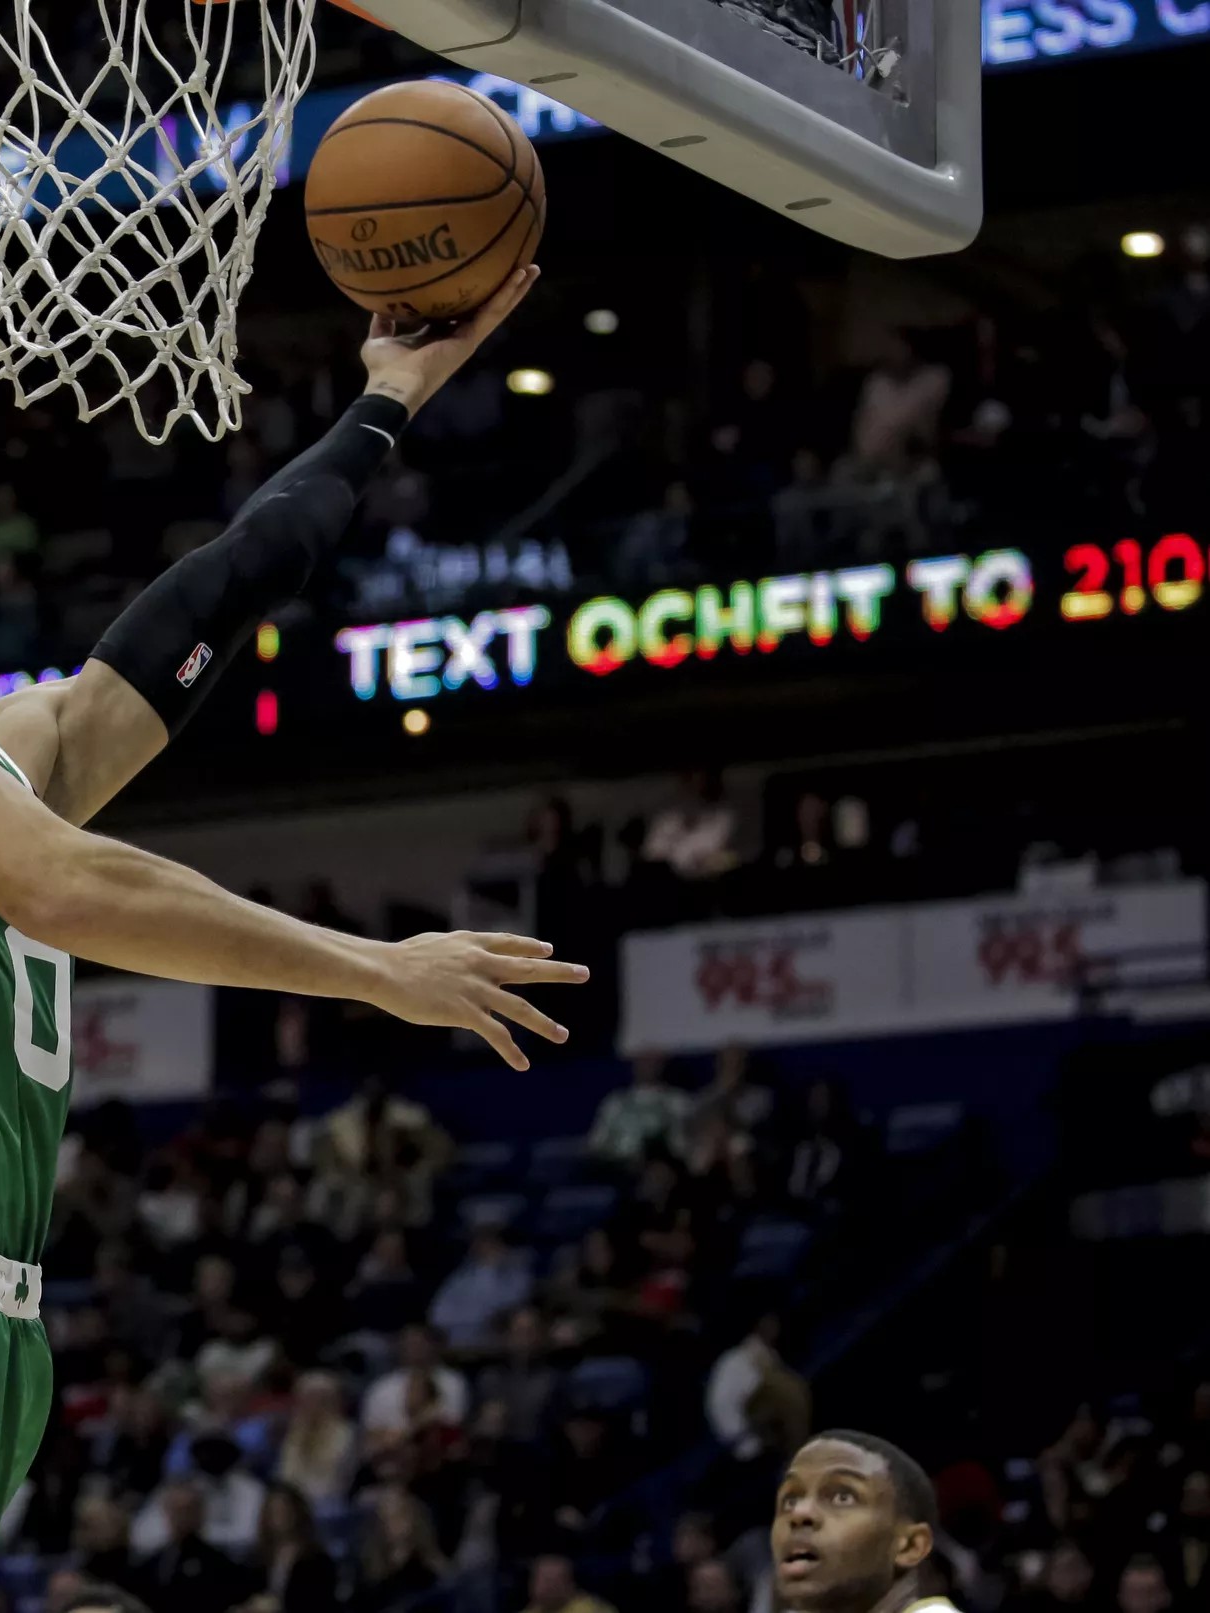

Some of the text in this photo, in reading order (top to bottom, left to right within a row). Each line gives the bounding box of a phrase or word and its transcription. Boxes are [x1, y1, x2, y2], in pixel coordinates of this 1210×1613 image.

[335, 604, 551, 700] TEXT
[567, 562, 896, 676] OCHFIT
[906, 547, 1034, 632] TO
[1061, 533, 1206, 622] 210
[4, 924, 72, 1092] 0
